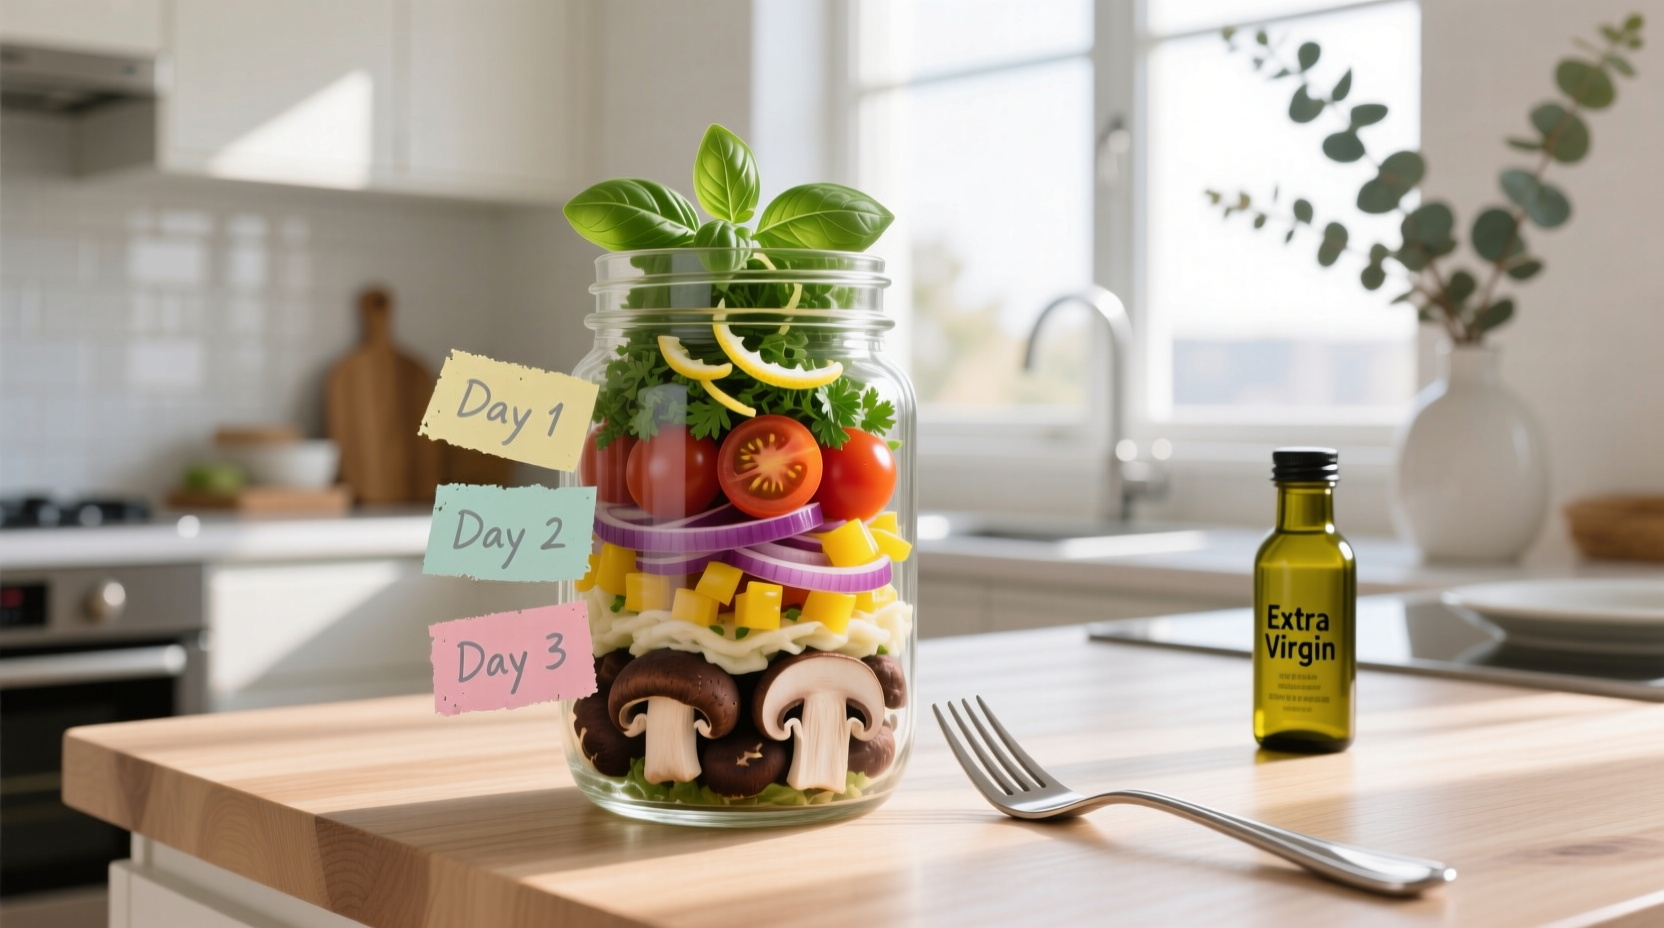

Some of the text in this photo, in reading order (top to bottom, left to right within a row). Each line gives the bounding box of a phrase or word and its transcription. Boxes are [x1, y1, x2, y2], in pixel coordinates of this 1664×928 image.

[457, 378, 564, 446] Day 1
[452, 509, 566, 570] Day 2
[1267, 604, 1330, 632] Extra
[457, 632, 567, 695] Day 3
[1265, 633, 1335, 667] Virgin
